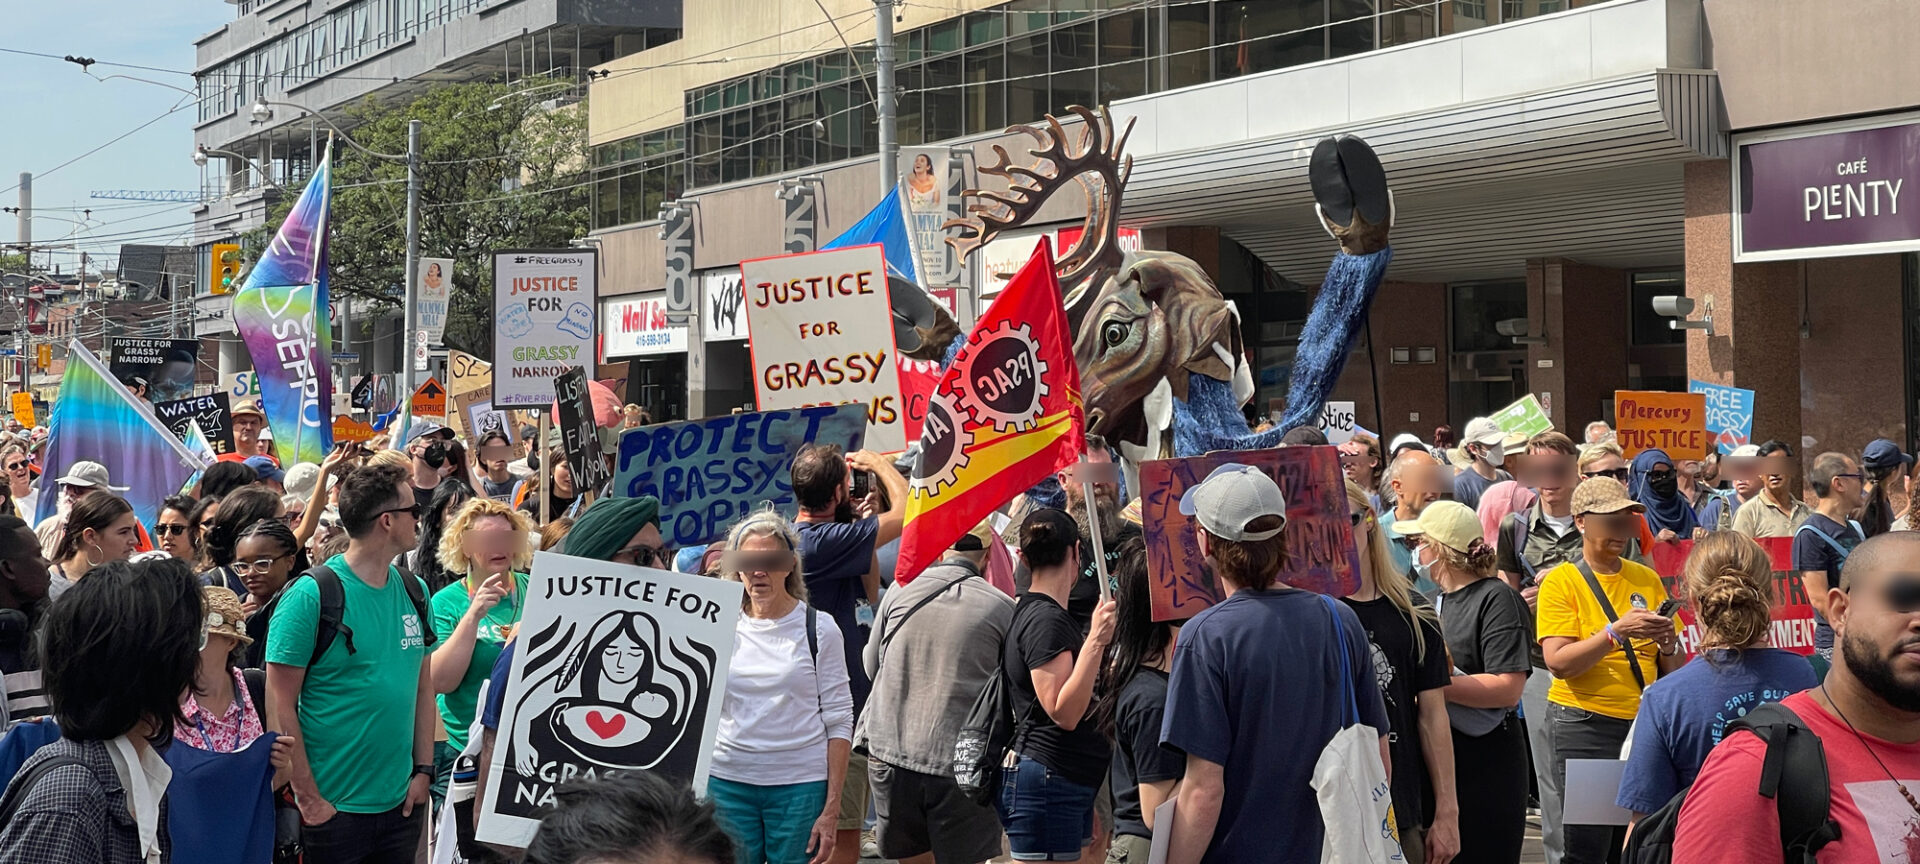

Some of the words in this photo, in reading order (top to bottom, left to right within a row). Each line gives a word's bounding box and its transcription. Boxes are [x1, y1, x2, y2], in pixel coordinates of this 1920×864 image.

[1838, 157, 1868, 175] CAFÉ
[1804, 178, 1903, 222] PLENTY
[510, 276, 578, 296] JUSTICE
[755, 271, 875, 308] JUSTICE
[528, 297, 562, 312] FOR
[575, 308, 588, 318] NO
[622, 301, 648, 333] Nail
[799, 321, 842, 340] FOR
[114, 339, 152, 348] JUSTICE
[154, 340, 172, 348] FOR
[124, 347, 160, 356] GRASSY
[513, 345, 580, 361] GRASSY
[119, 355, 164, 364] NARROWS
[764, 349, 887, 391] GRASSY
[512, 365, 573, 378] NARROW
[160, 396, 217, 418] WATER
[1318, 404, 1354, 432] stice
[1706, 405, 1751, 431] RASSY
[211, 440, 226, 453] FE
[620, 405, 838, 473] PROTECT
[1619, 428, 1701, 450] JUSTICE
[545, 575, 657, 603] JUSTICE
[665, 587, 721, 623] FOR
[1712, 712, 1726, 745] HELP
[1725, 691, 1755, 711] SAVE
[1763, 689, 1790, 699] OUR
